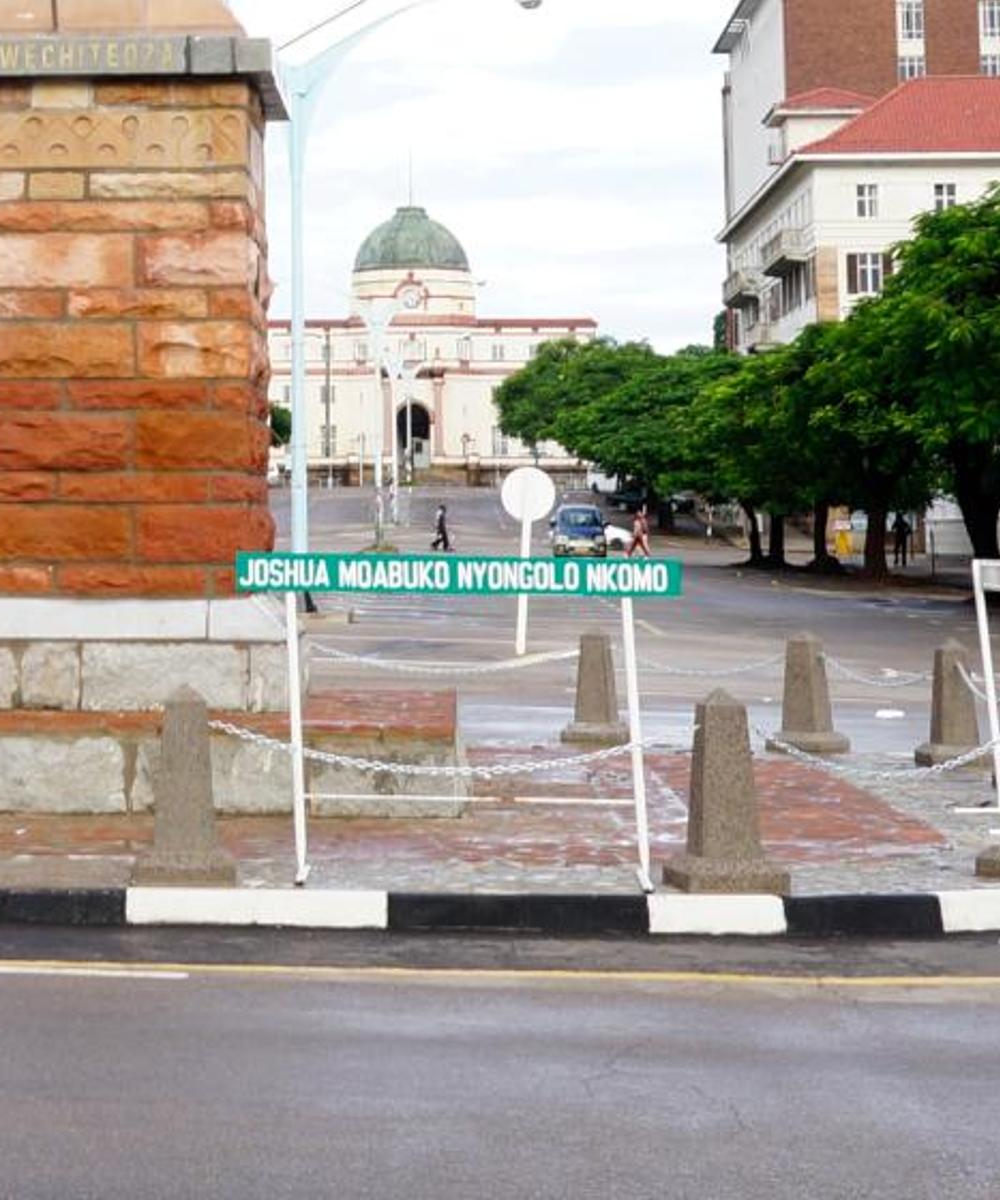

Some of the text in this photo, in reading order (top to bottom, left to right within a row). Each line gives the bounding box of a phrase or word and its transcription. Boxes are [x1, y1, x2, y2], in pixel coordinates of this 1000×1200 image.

[239, 558, 330, 587] JOSHUA
[457, 561, 580, 591] NYONGOLO
[586, 563, 668, 593] NKOMO
